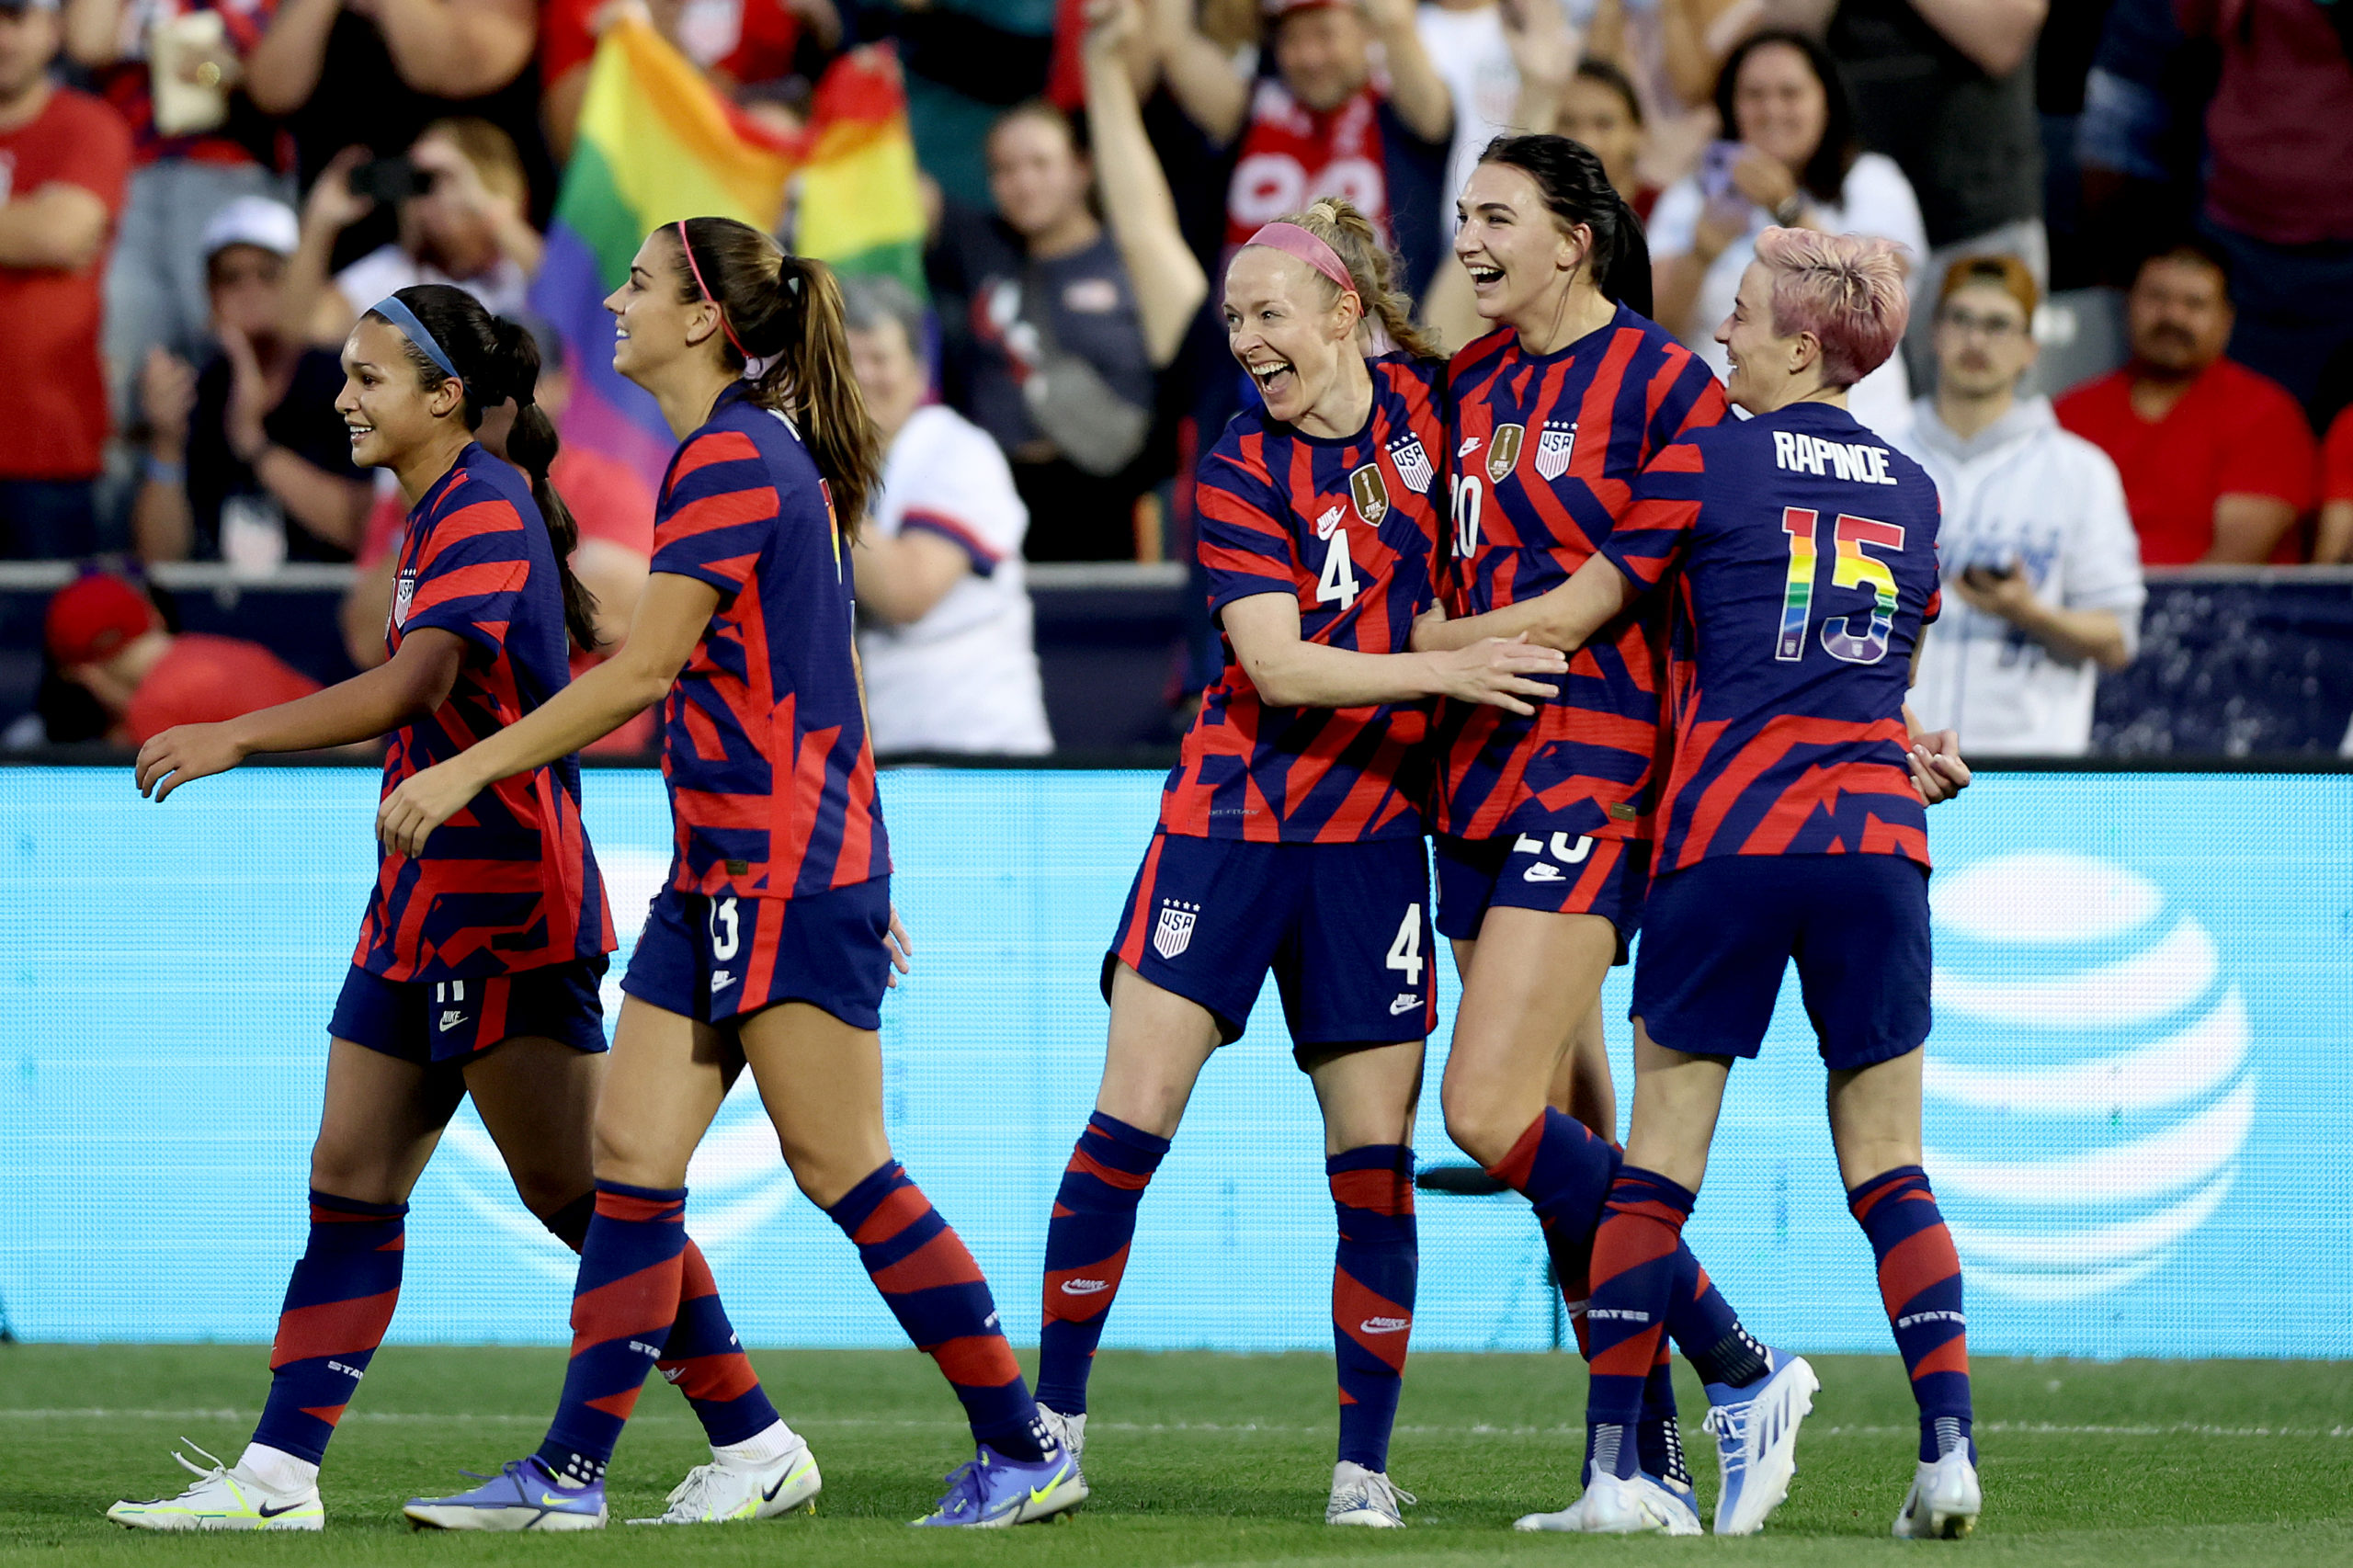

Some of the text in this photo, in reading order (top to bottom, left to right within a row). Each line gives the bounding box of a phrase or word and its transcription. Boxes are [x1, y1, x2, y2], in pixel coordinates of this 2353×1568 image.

[1395, 445, 1423, 468] USA
[1542, 433, 1571, 452] USA
[1772, 431, 1898, 485] RAPINOE
[1316, 506, 1339, 531] NIKE
[1316, 528, 1359, 611] 4
[1775, 506, 1905, 665] 15
[709, 895, 739, 961] 3
[1162, 911, 1194, 931] USA
[1386, 903, 1424, 985] 4
[1586, 1308, 1650, 1323] TATES
